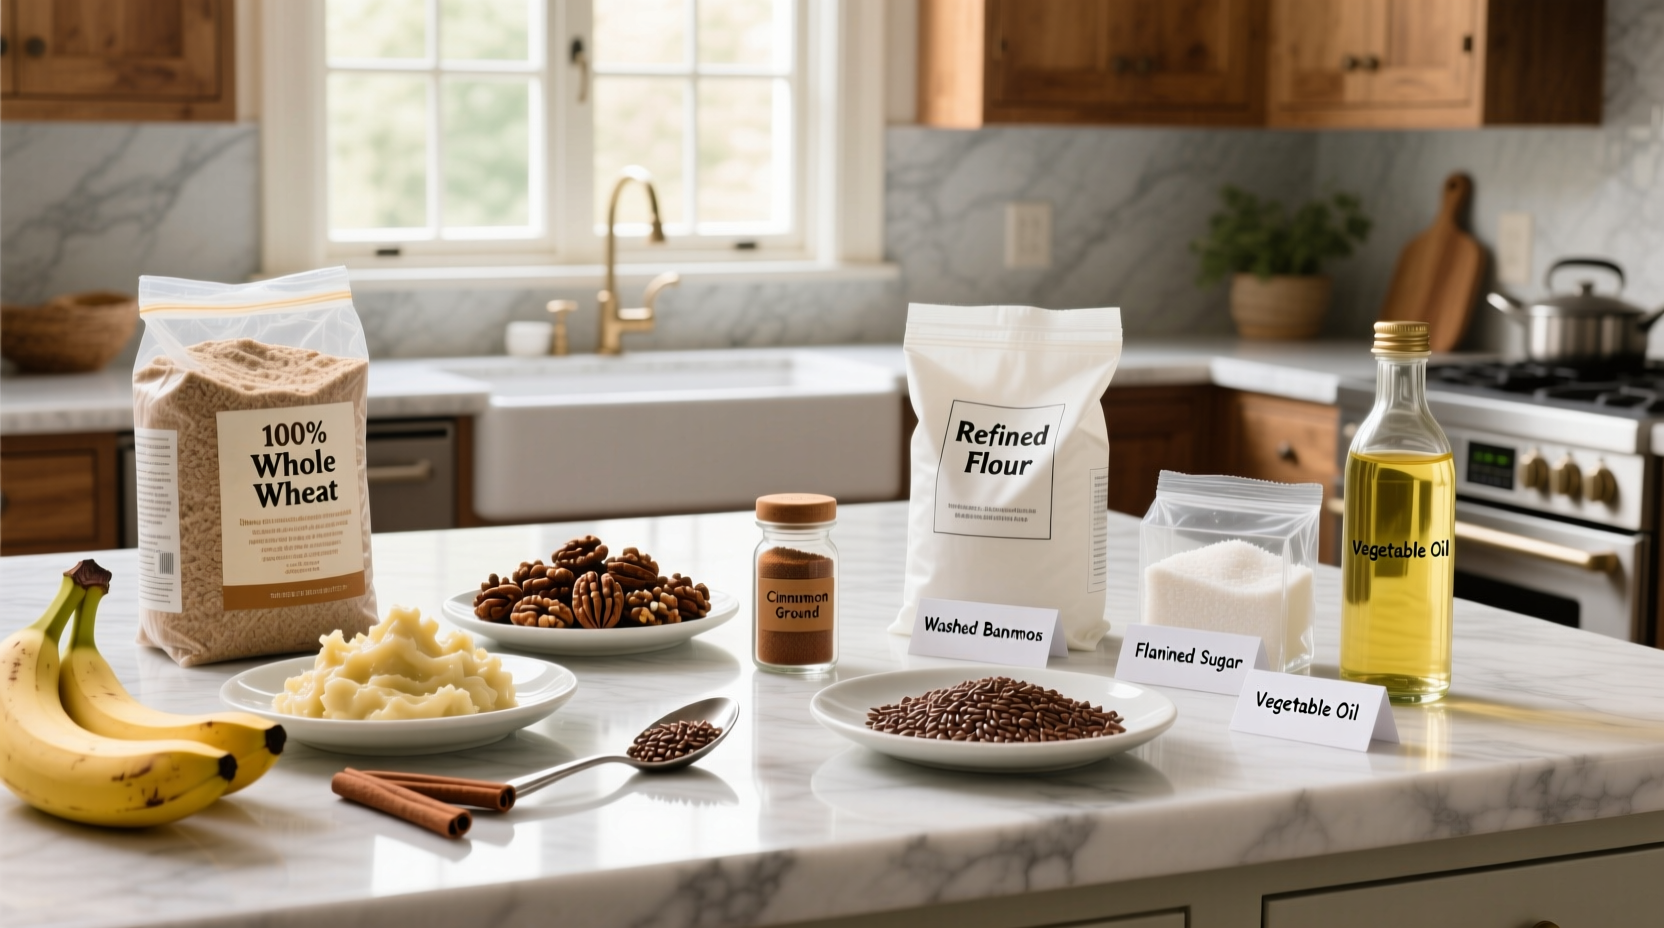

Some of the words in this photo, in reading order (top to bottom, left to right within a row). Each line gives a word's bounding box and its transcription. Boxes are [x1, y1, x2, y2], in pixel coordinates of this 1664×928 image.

[262, 420, 327, 447] 100%
[955, 420, 1050, 447] Refined
[250, 448, 336, 479] Whole
[964, 451, 1033, 476] Flour
[252, 480, 339, 509] Wheat
[1352, 539, 1426, 562] Vegetable
[1430, 539, 1449, 558] Oil
[924, 616, 979, 636] Washed
[1200, 650, 1244, 672] Sugar
[1256, 691, 1332, 717] Vegetable
[1337, 702, 1360, 721] Oil
